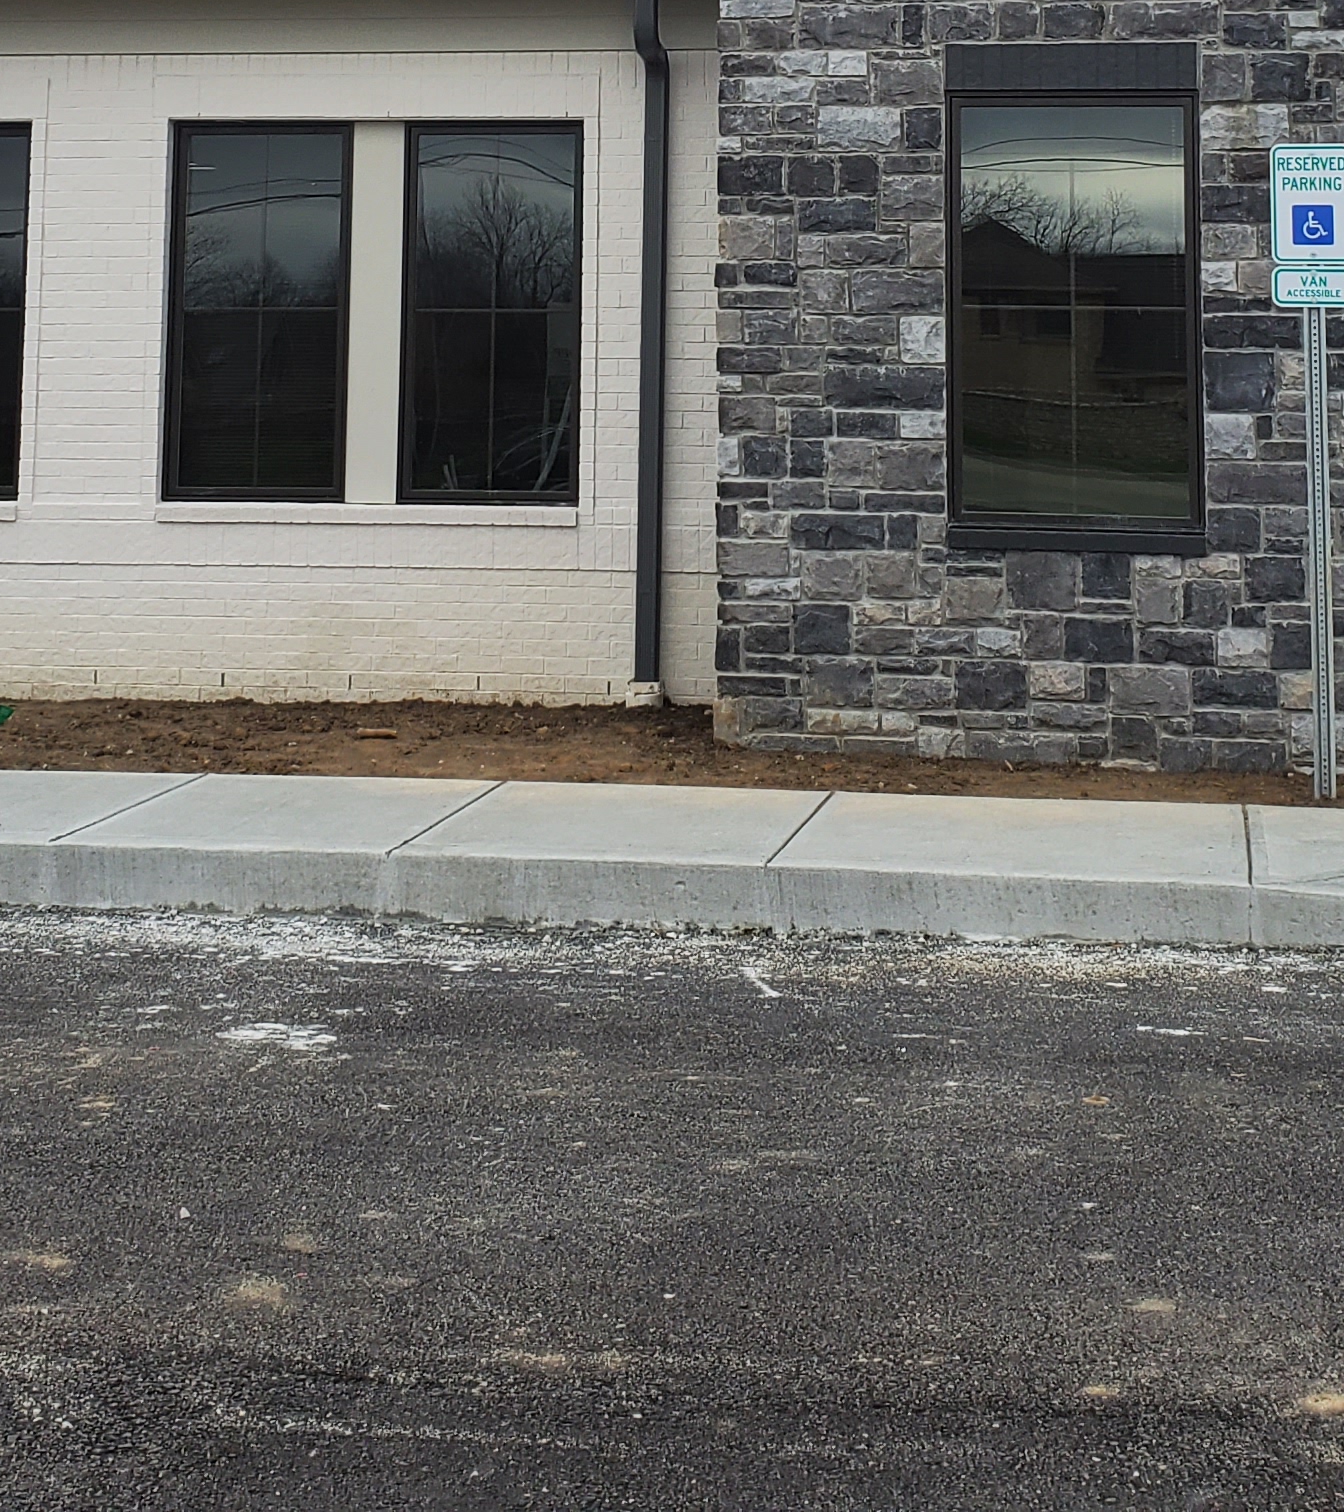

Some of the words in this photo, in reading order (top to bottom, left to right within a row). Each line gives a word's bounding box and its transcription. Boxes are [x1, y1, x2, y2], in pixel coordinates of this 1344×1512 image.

[1282, 177, 1342, 191] PARKING
[1300, 276, 1327, 287] VAN
[1286, 289, 1341, 298] ACCESSIBLE
